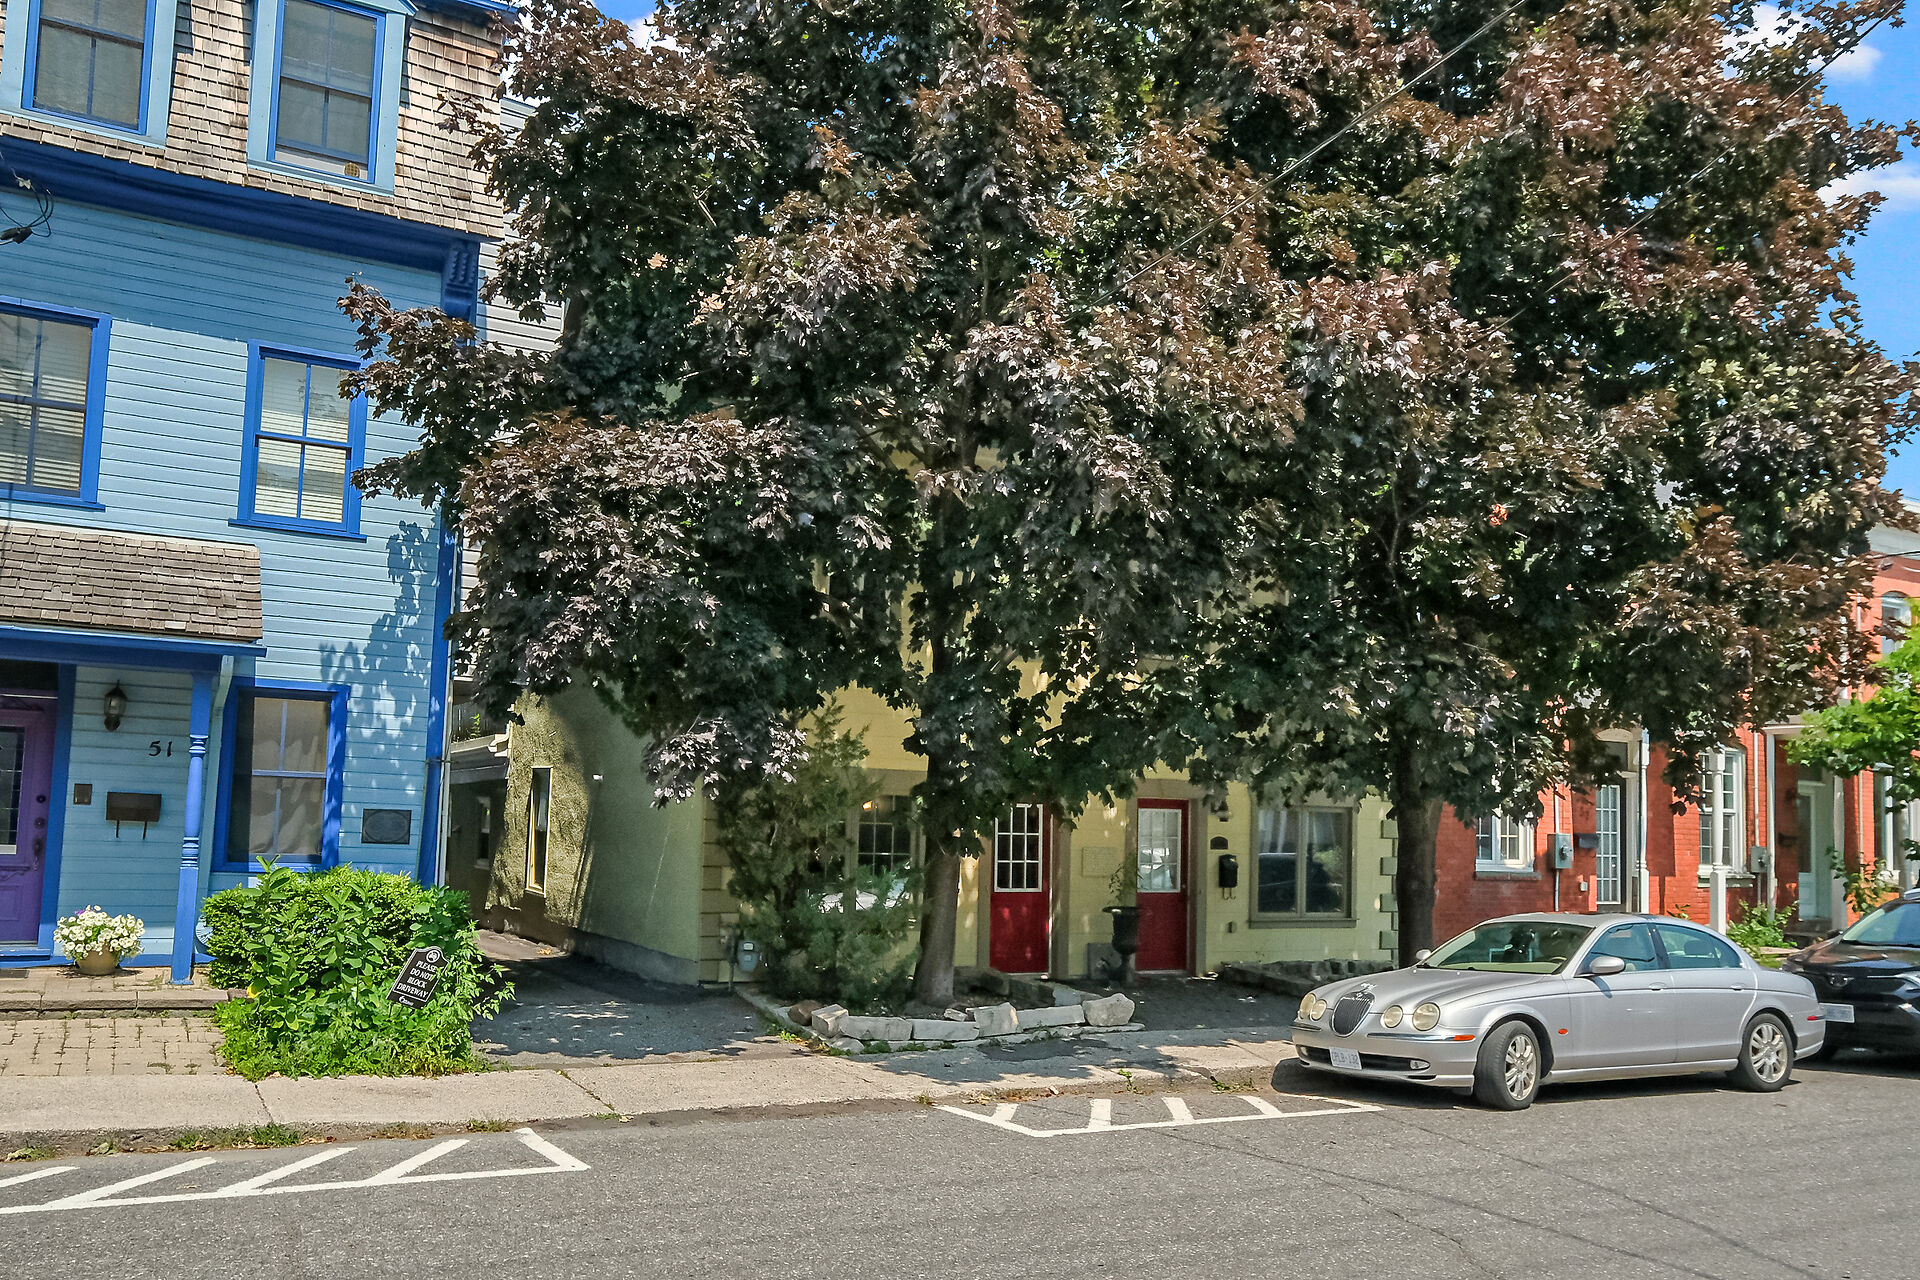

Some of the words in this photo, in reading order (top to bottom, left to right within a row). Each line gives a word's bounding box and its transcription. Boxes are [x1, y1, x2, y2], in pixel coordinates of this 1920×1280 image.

[149, 740, 172, 757] 51
[416, 961, 437, 972] PLEASE
[410, 968, 420, 976] DO
[420, 971, 433, 980] NOT
[407, 977, 427, 988] BLOCK
[397, 983, 428, 997] DRIVEWAY
